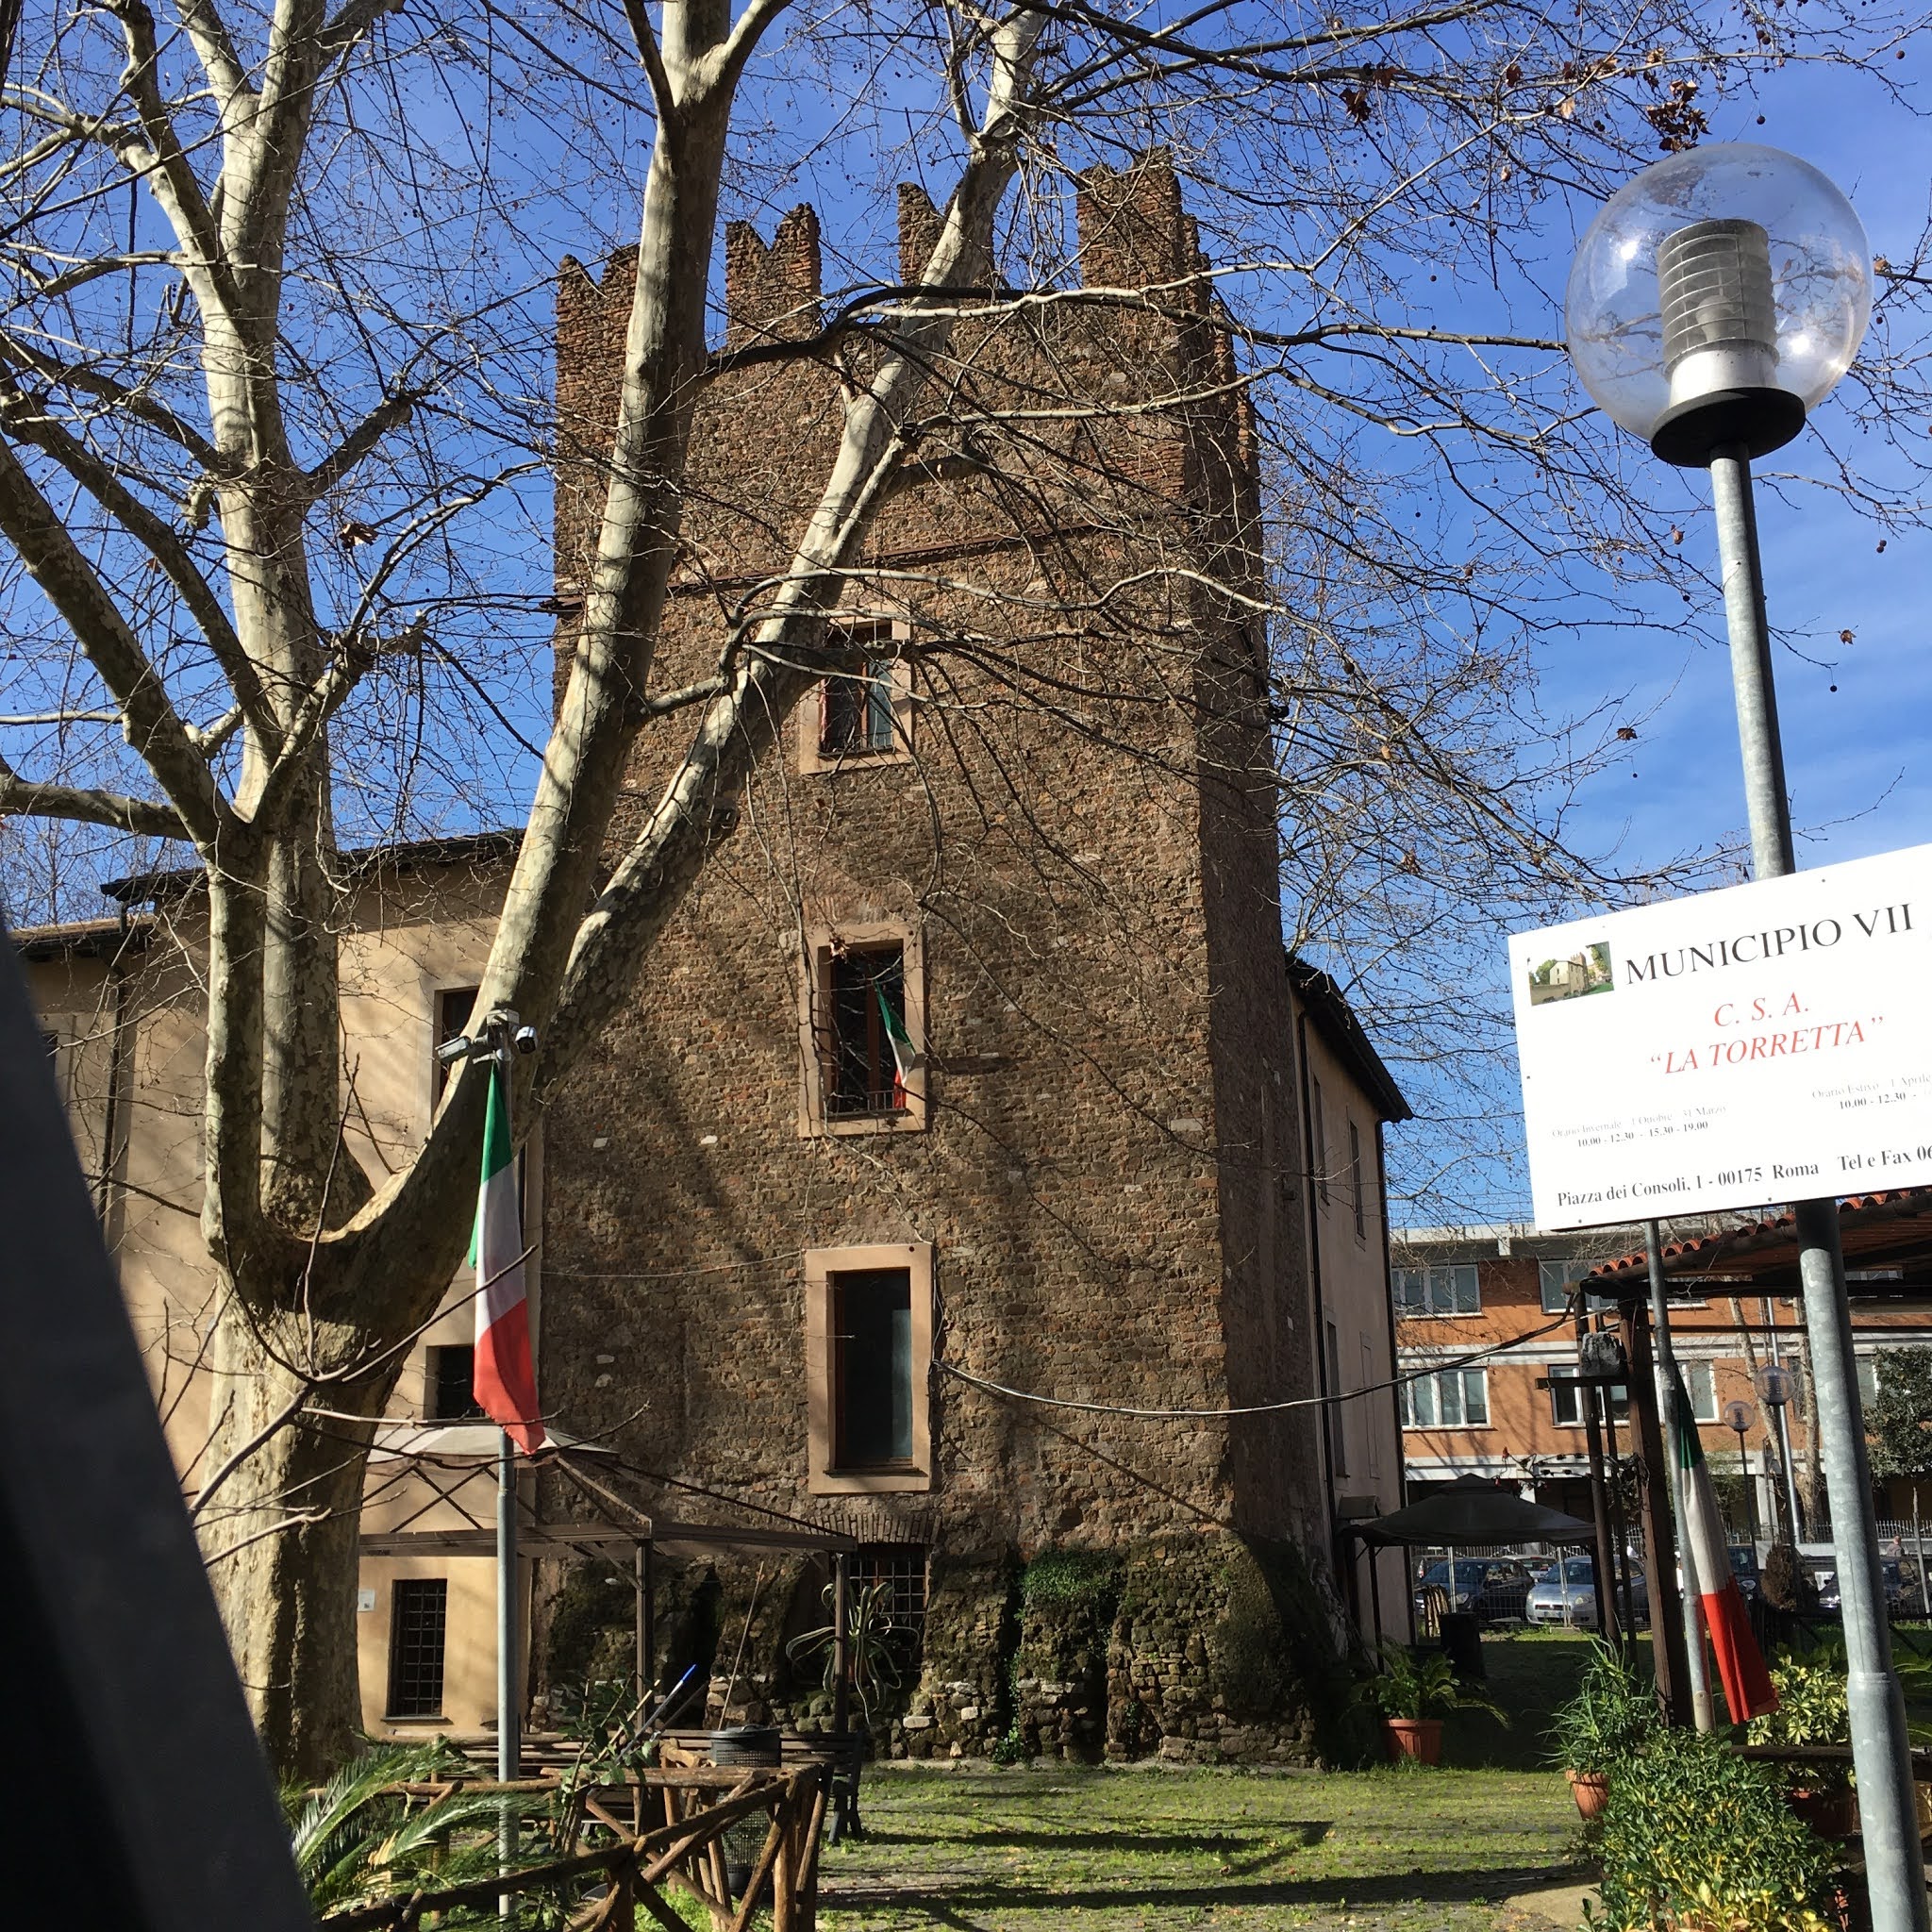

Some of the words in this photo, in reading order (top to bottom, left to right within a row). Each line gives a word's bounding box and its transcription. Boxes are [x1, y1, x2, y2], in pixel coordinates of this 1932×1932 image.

[1625, 919, 1842, 985] MUNICIPIO
[1852, 903, 1915, 938] VII
[1713, 1003, 1740, 1027] C.
[1751, 997, 1773, 1021] S.
[1782, 991, 1809, 1016] A.
[1840, 1097, 1867, 1110] 10.00
[1577, 1137, 1602, 1148] 10.00
[1683, 1121, 1708, 1133] 19.00
[1557, 1191, 1603, 1207] Piazza
[1606, 1184, 1627, 1201] dei
[1631, 1176, 1691, 1197] Consoli,
[1717, 1166, 1763, 1186] 00175
[1772, 1163, 1820, 1180] Roma
[1837, 1154, 1862, 1171] Tel
[1867, 1157, 1875, 1168] e
[1881, 1149, 1912, 1166] Fax
